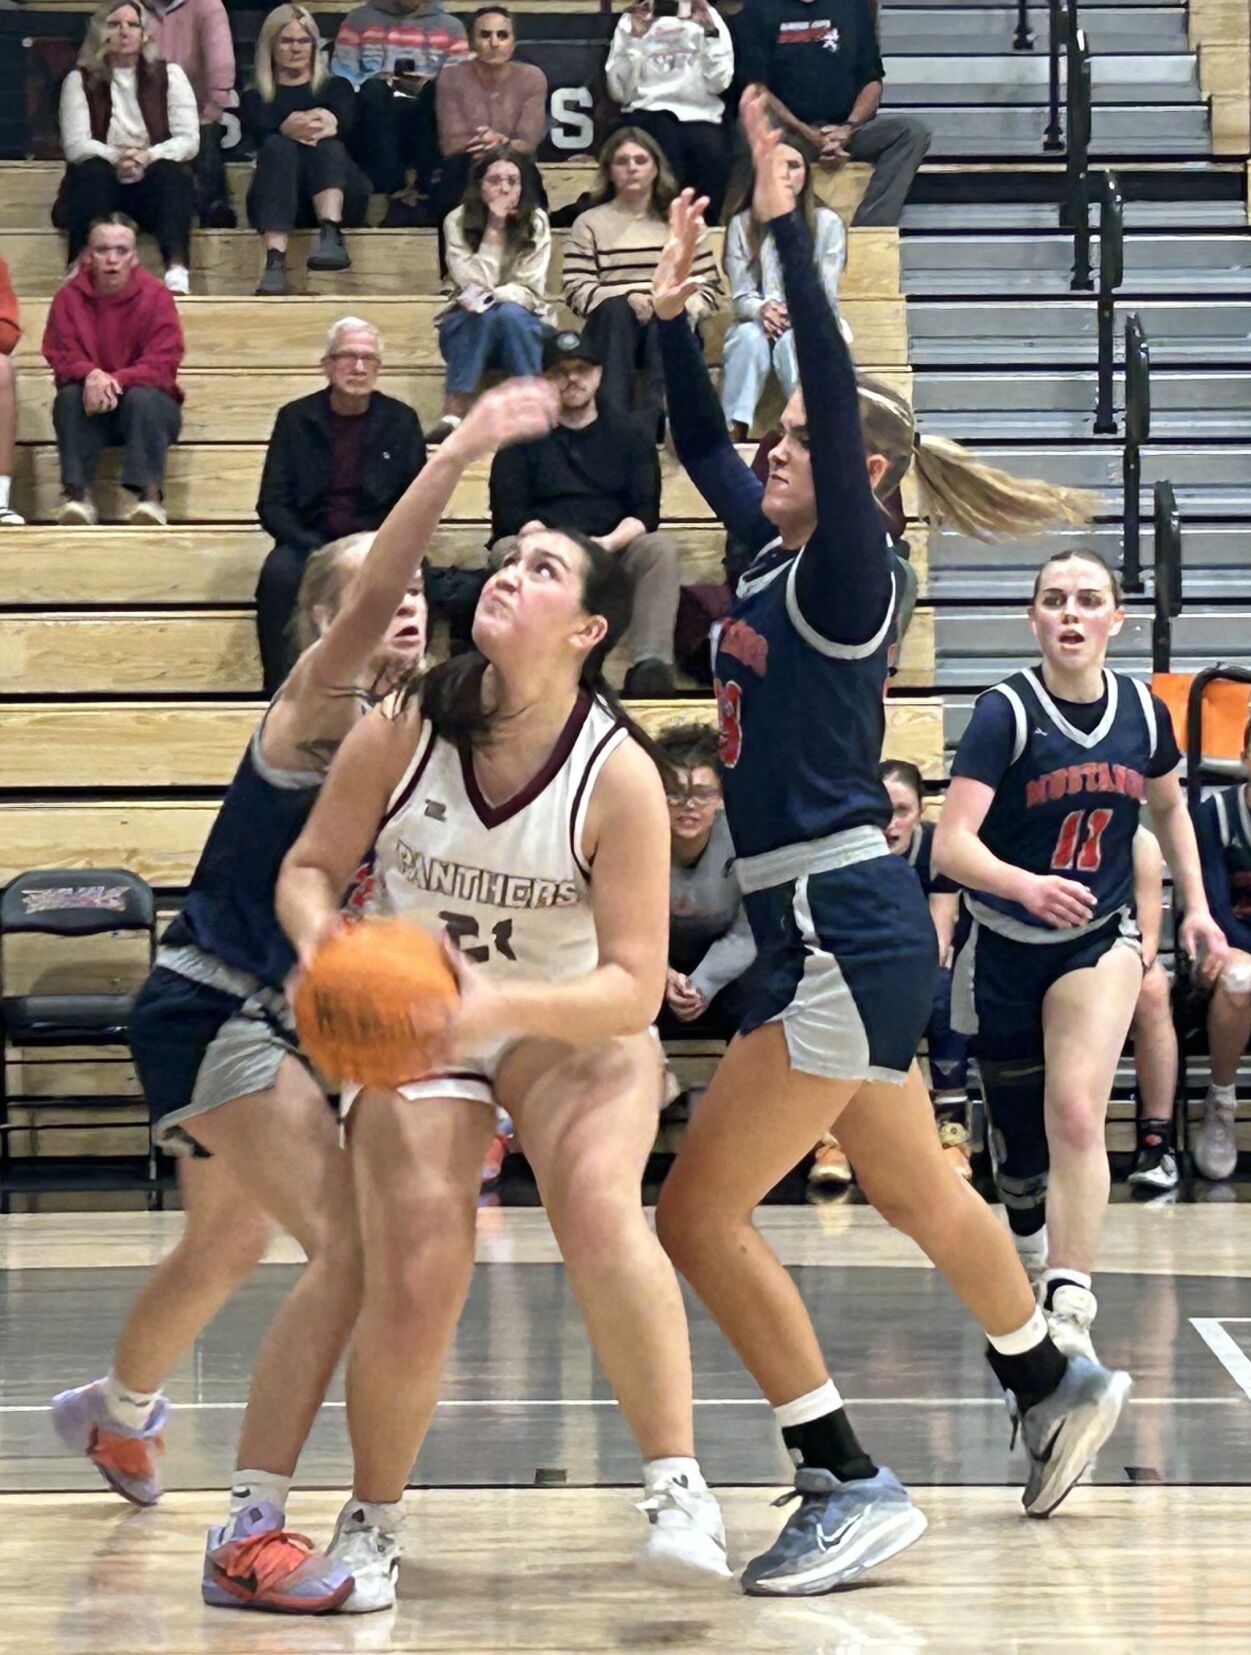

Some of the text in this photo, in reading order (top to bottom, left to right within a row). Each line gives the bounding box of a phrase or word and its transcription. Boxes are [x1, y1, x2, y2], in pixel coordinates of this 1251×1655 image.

[551, 86, 594, 149] S
[1050, 808, 1114, 872] 11
[395, 839, 579, 909] PANTHERS
